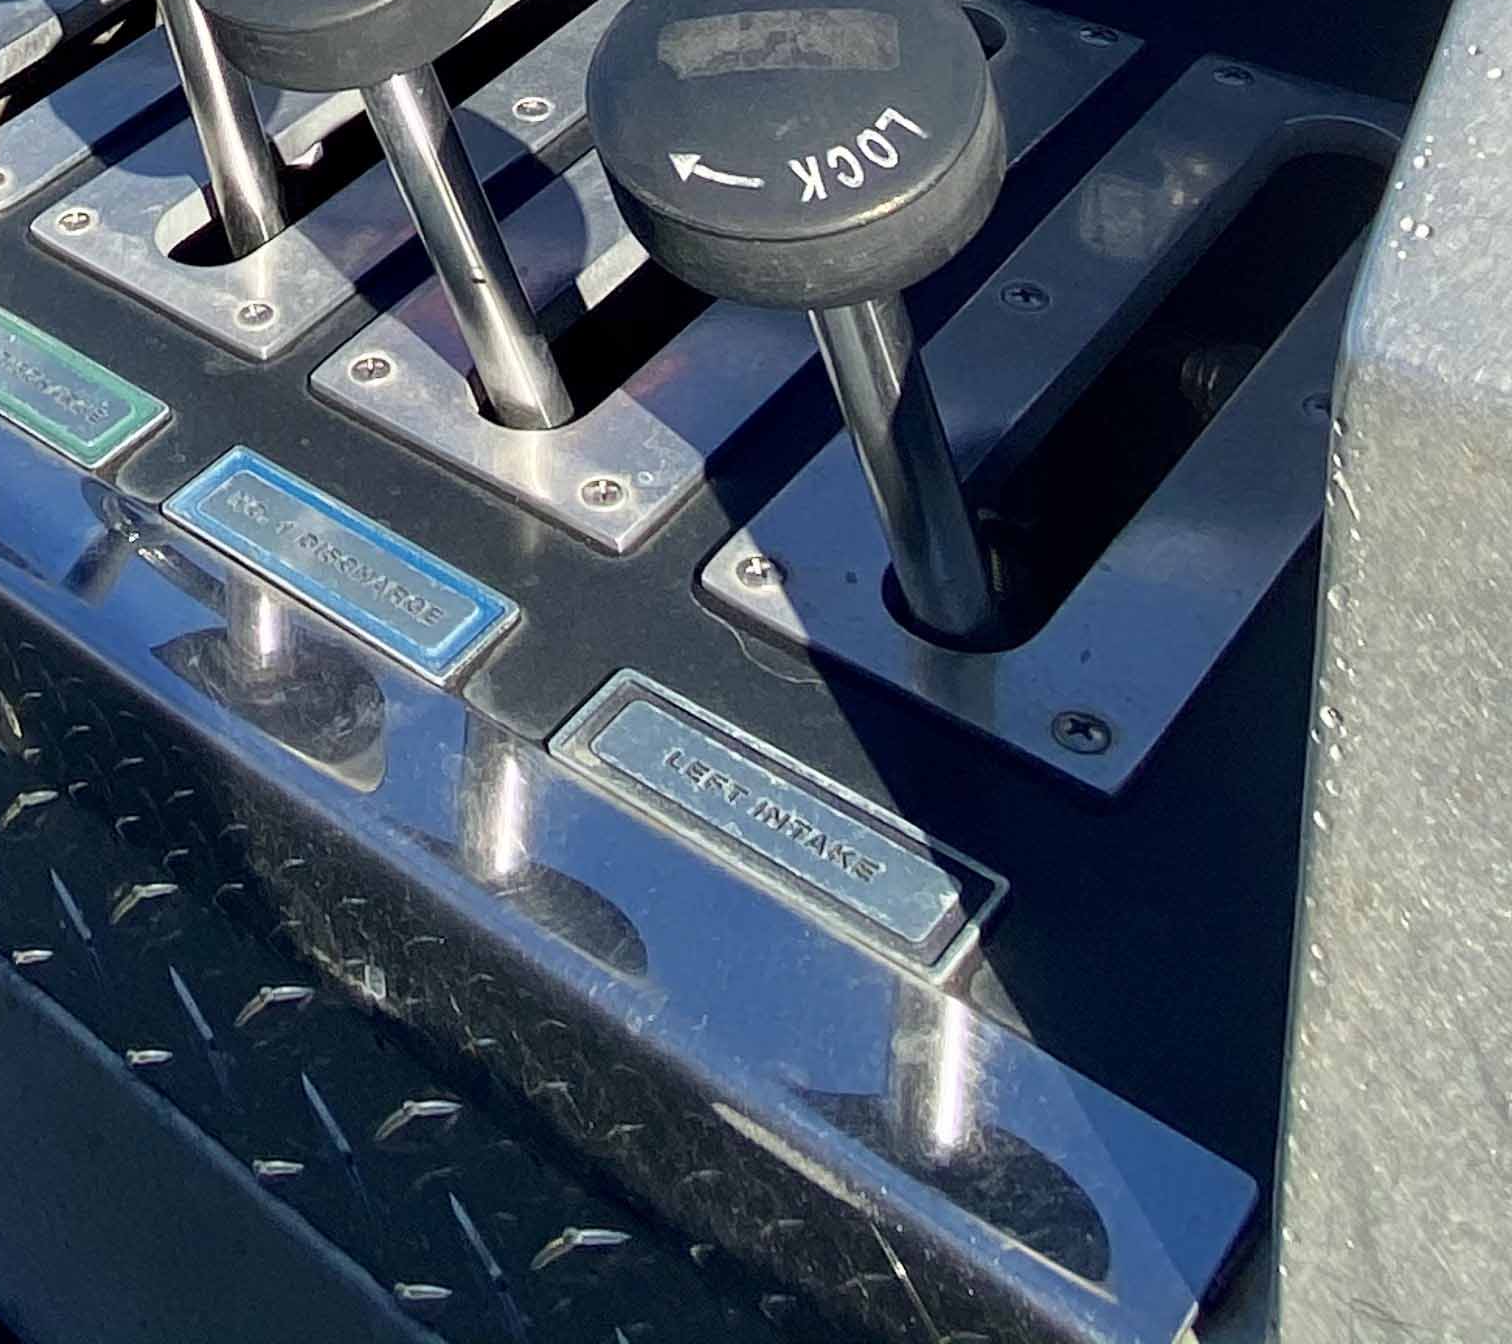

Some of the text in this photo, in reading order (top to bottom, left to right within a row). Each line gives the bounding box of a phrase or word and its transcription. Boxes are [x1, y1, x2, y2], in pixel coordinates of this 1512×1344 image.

[788, 107, 929, 203] LOCK
[296, 530, 445, 628] DISCHARGE
[663, 746, 887, 885] LEFT INTAKE
